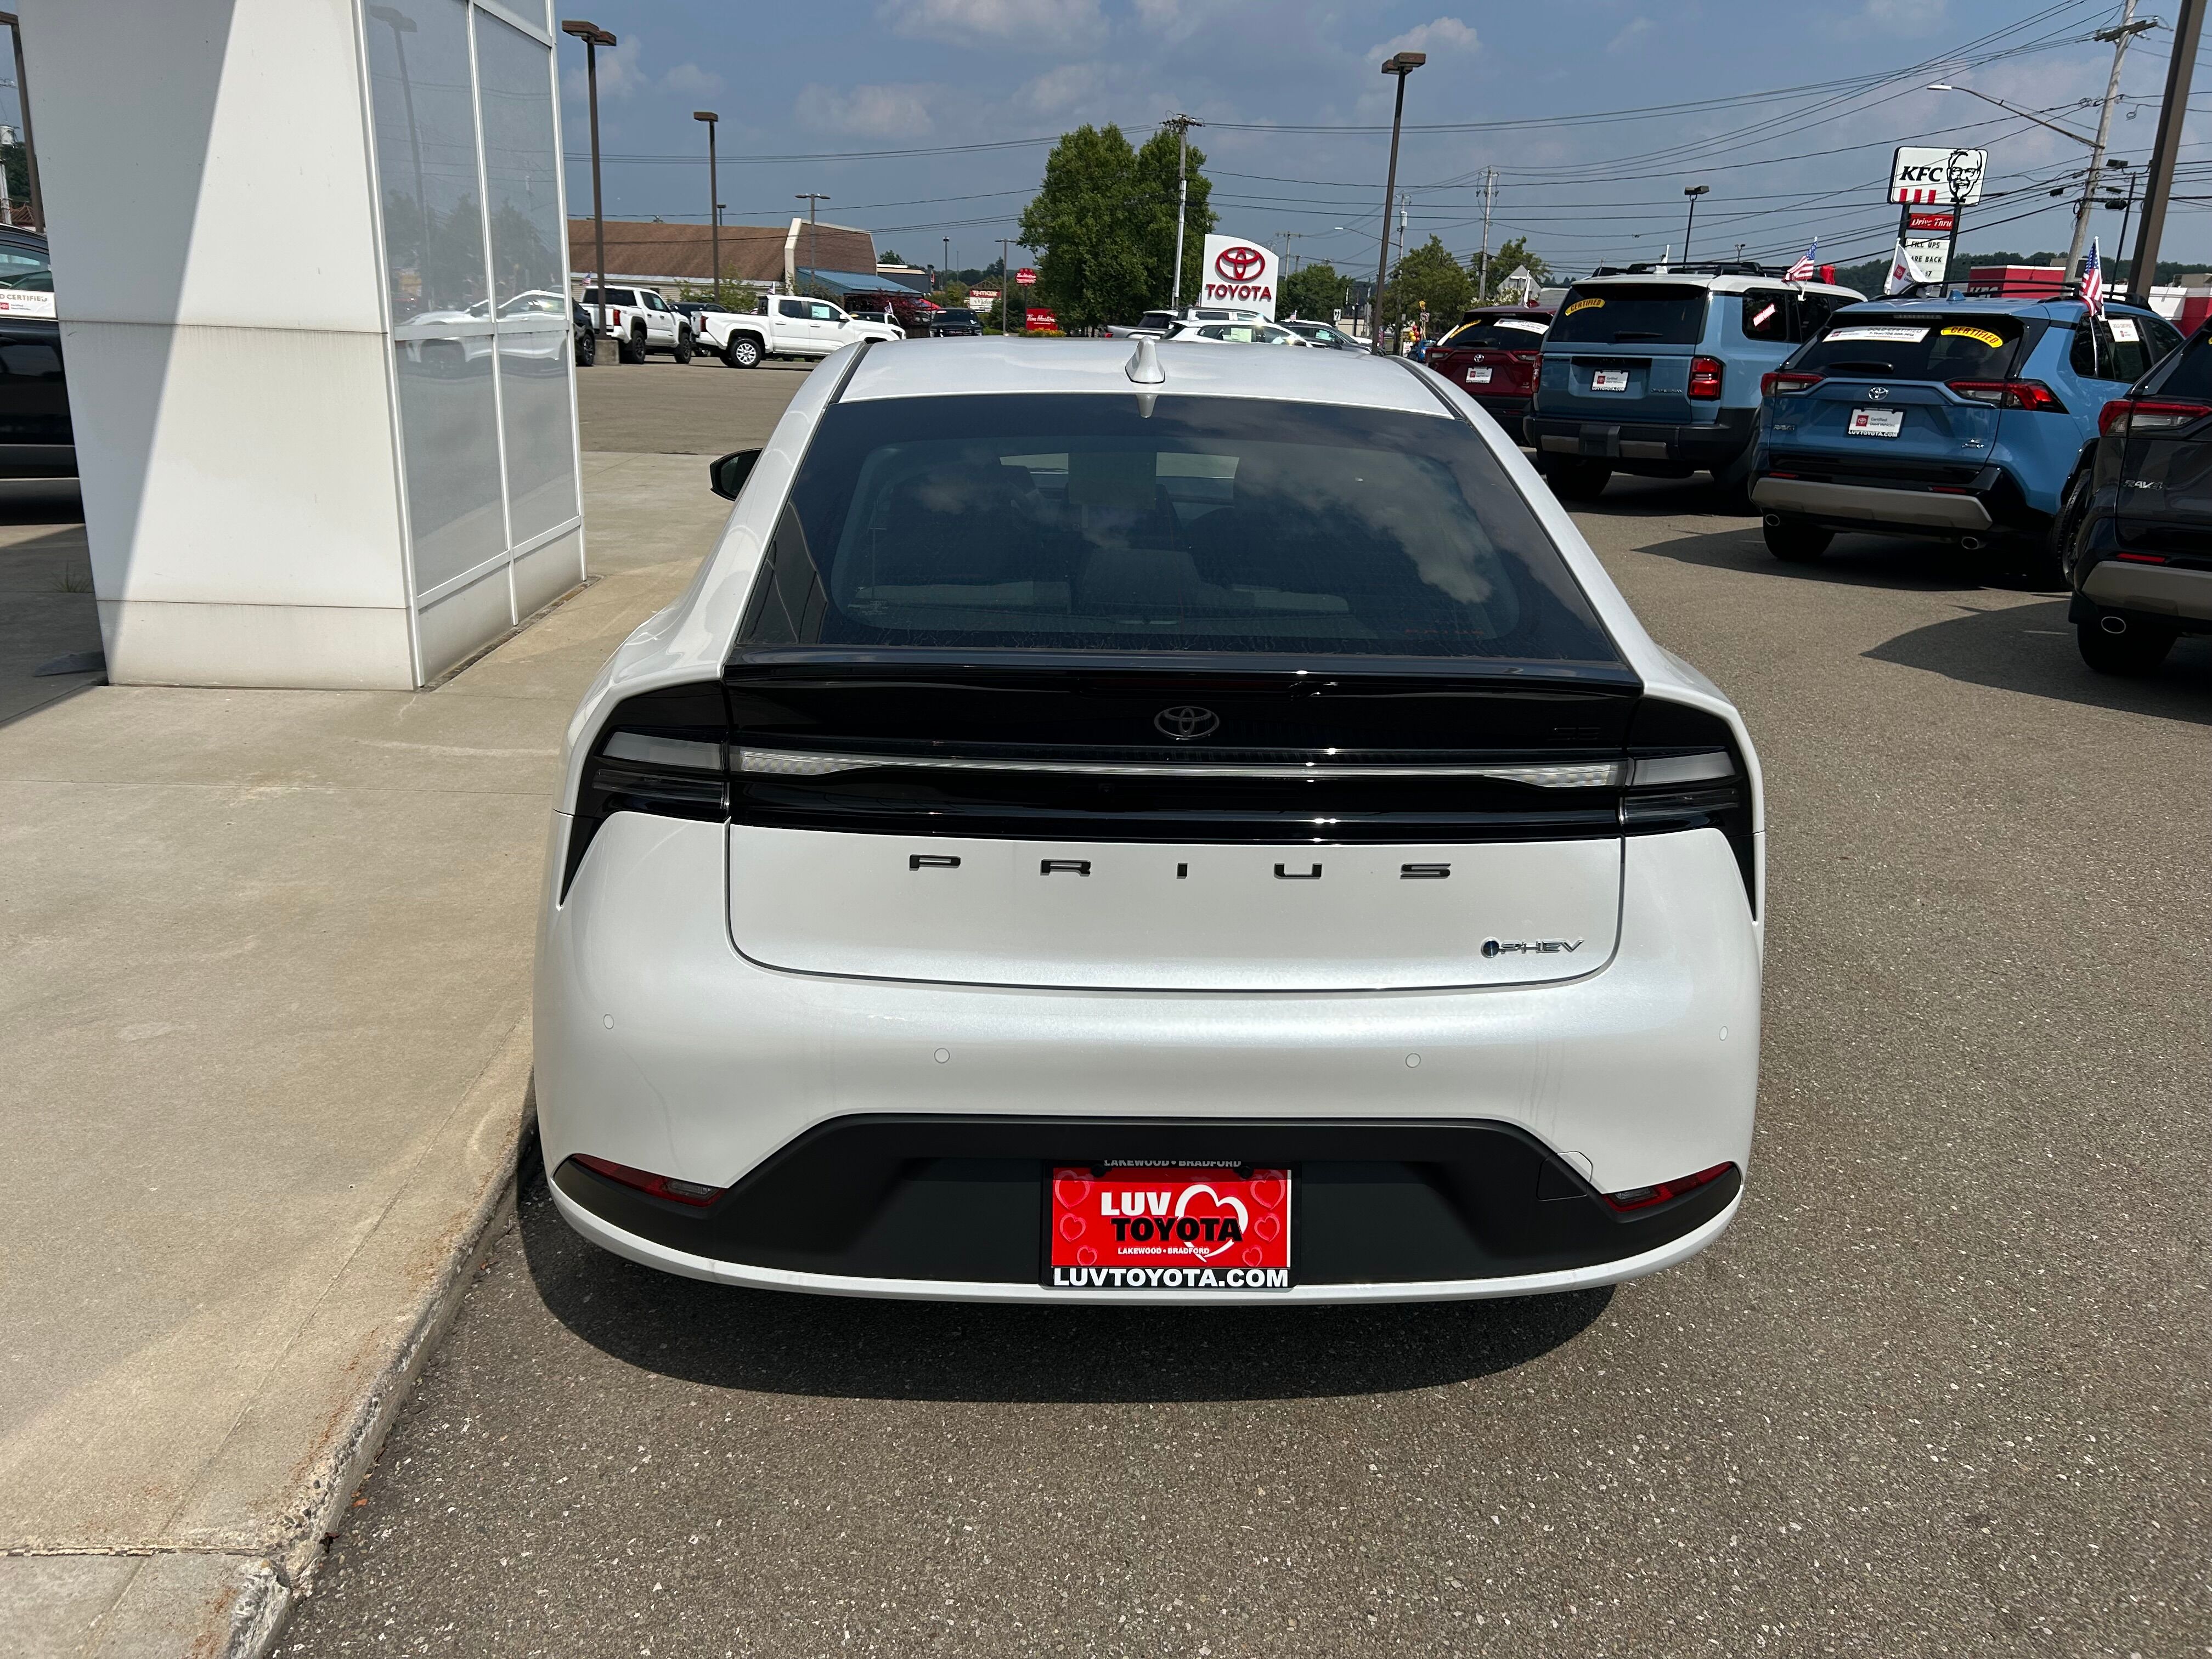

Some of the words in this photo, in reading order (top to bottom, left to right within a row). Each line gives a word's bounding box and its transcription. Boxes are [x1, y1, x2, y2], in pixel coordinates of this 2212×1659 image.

[1899, 166, 1943, 182] KFC
[1934, 218, 1952, 227] Thru
[1206, 284, 1272, 300] TOYOTA
[1571, 300, 1601, 311] CERTIFIED
[1950, 327, 1999, 343] CERTIFIED
[2123, 480, 2163, 490] RAV4
[910, 854, 1452, 879] PRIUS
[1499, 934, 1584, 954] PHEV
[1102, 1192, 1171, 1216] LUV
[1111, 1217, 1243, 1242] TOYOTA
[1053, 1268, 1288, 1287] LUVTOYOTA.COM
